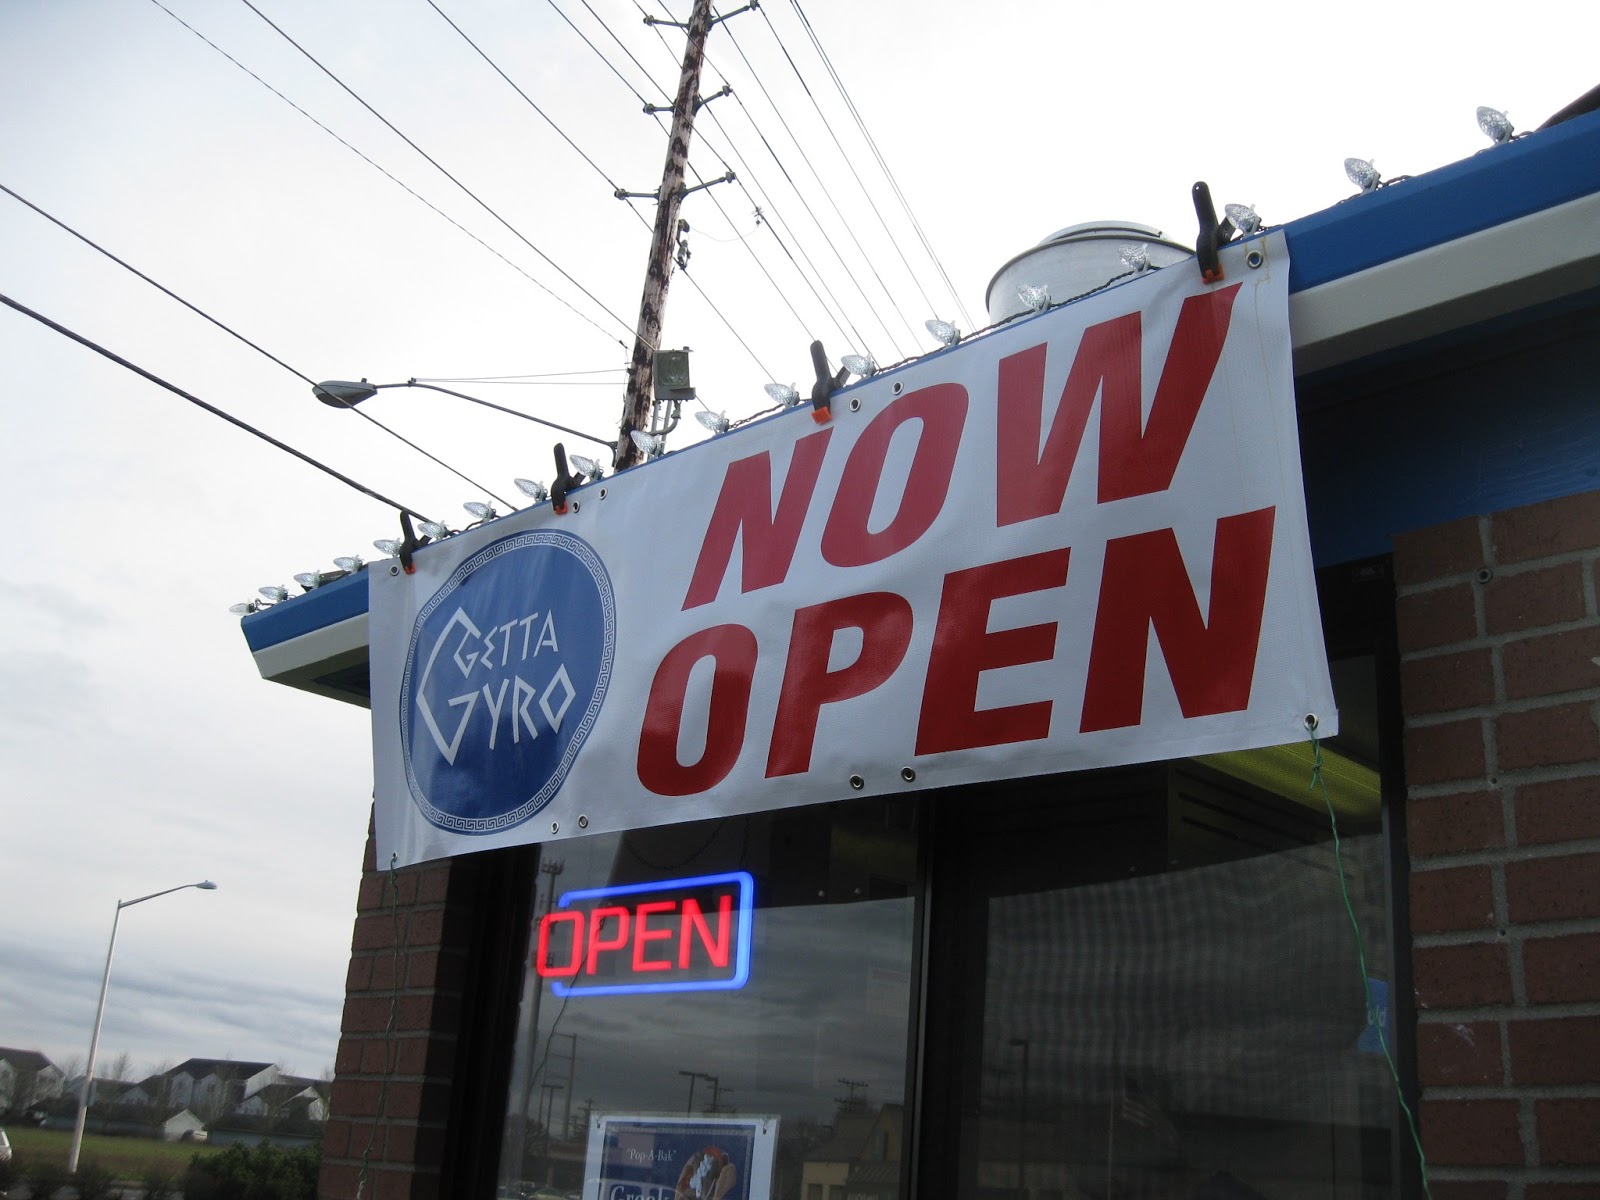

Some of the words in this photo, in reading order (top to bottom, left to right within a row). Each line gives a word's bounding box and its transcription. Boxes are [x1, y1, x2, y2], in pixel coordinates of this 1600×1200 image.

[681, 282, 1243, 611] NOW
[416, 607, 576, 766] GYRO
[453, 609, 559, 679] GETTA
[636, 505, 1276, 797] OPEN
[536, 895, 732, 977] OPEN
